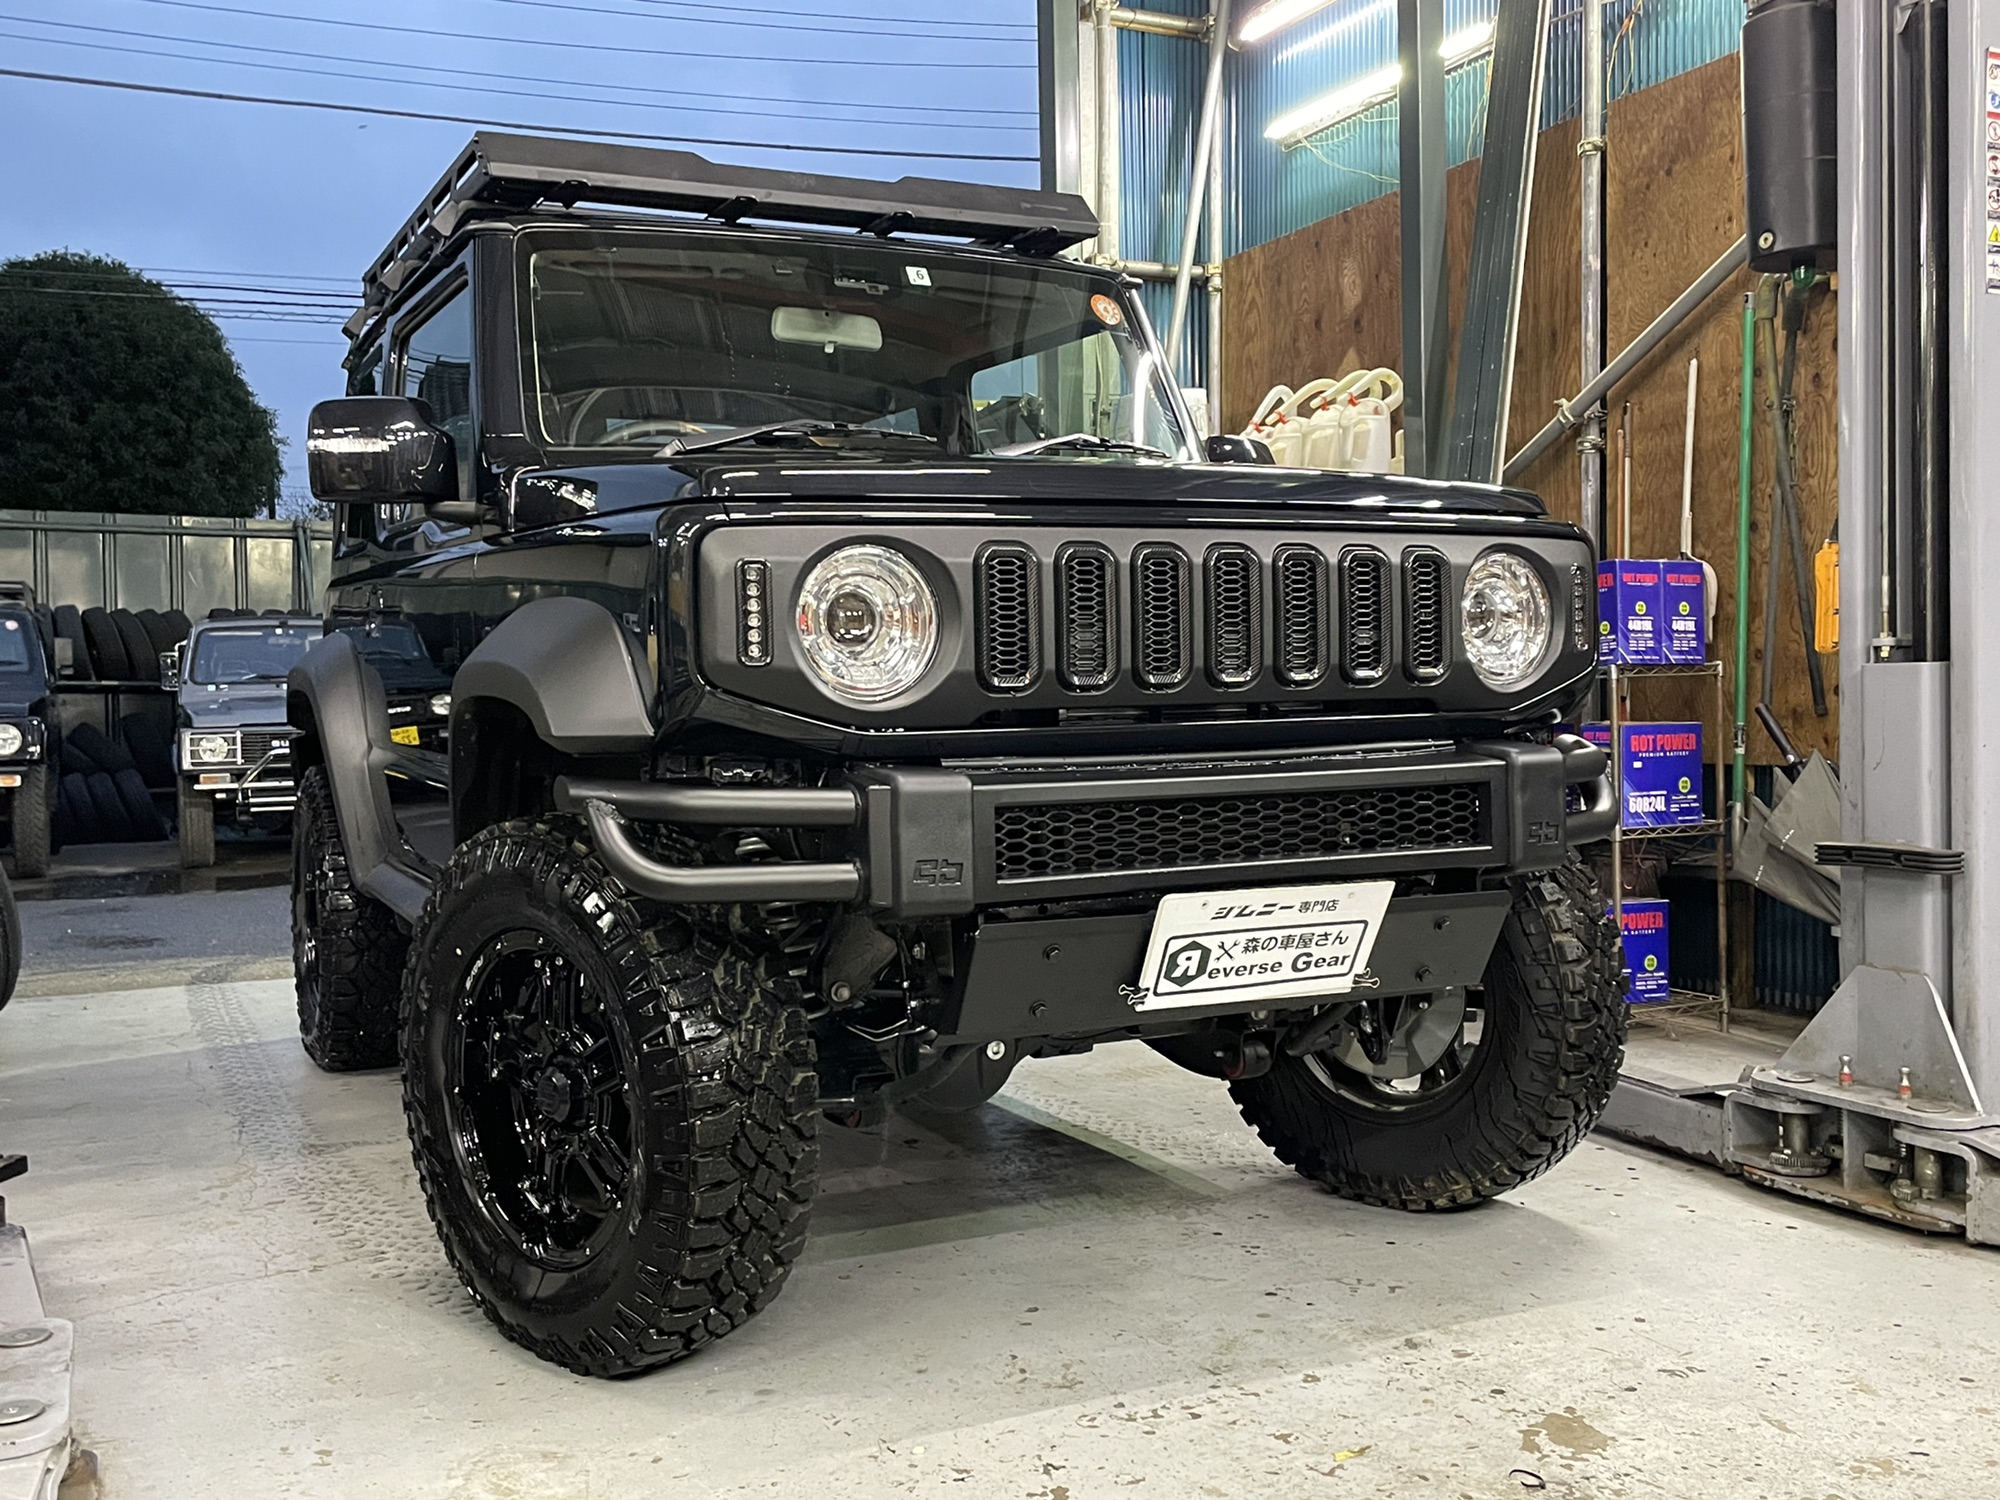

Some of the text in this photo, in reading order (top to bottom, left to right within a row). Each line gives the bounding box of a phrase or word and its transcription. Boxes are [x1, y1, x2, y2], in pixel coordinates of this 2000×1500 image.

[915, 269, 925, 281] 6
[1631, 733, 1696, 752] HOT POWER
[1629, 796, 1667, 813] 60B24L
[1621, 911, 1664, 929] POWER
[1241, 930, 1349, 955] 森の車屋さん
[1291, 951, 1351, 974] Gear
